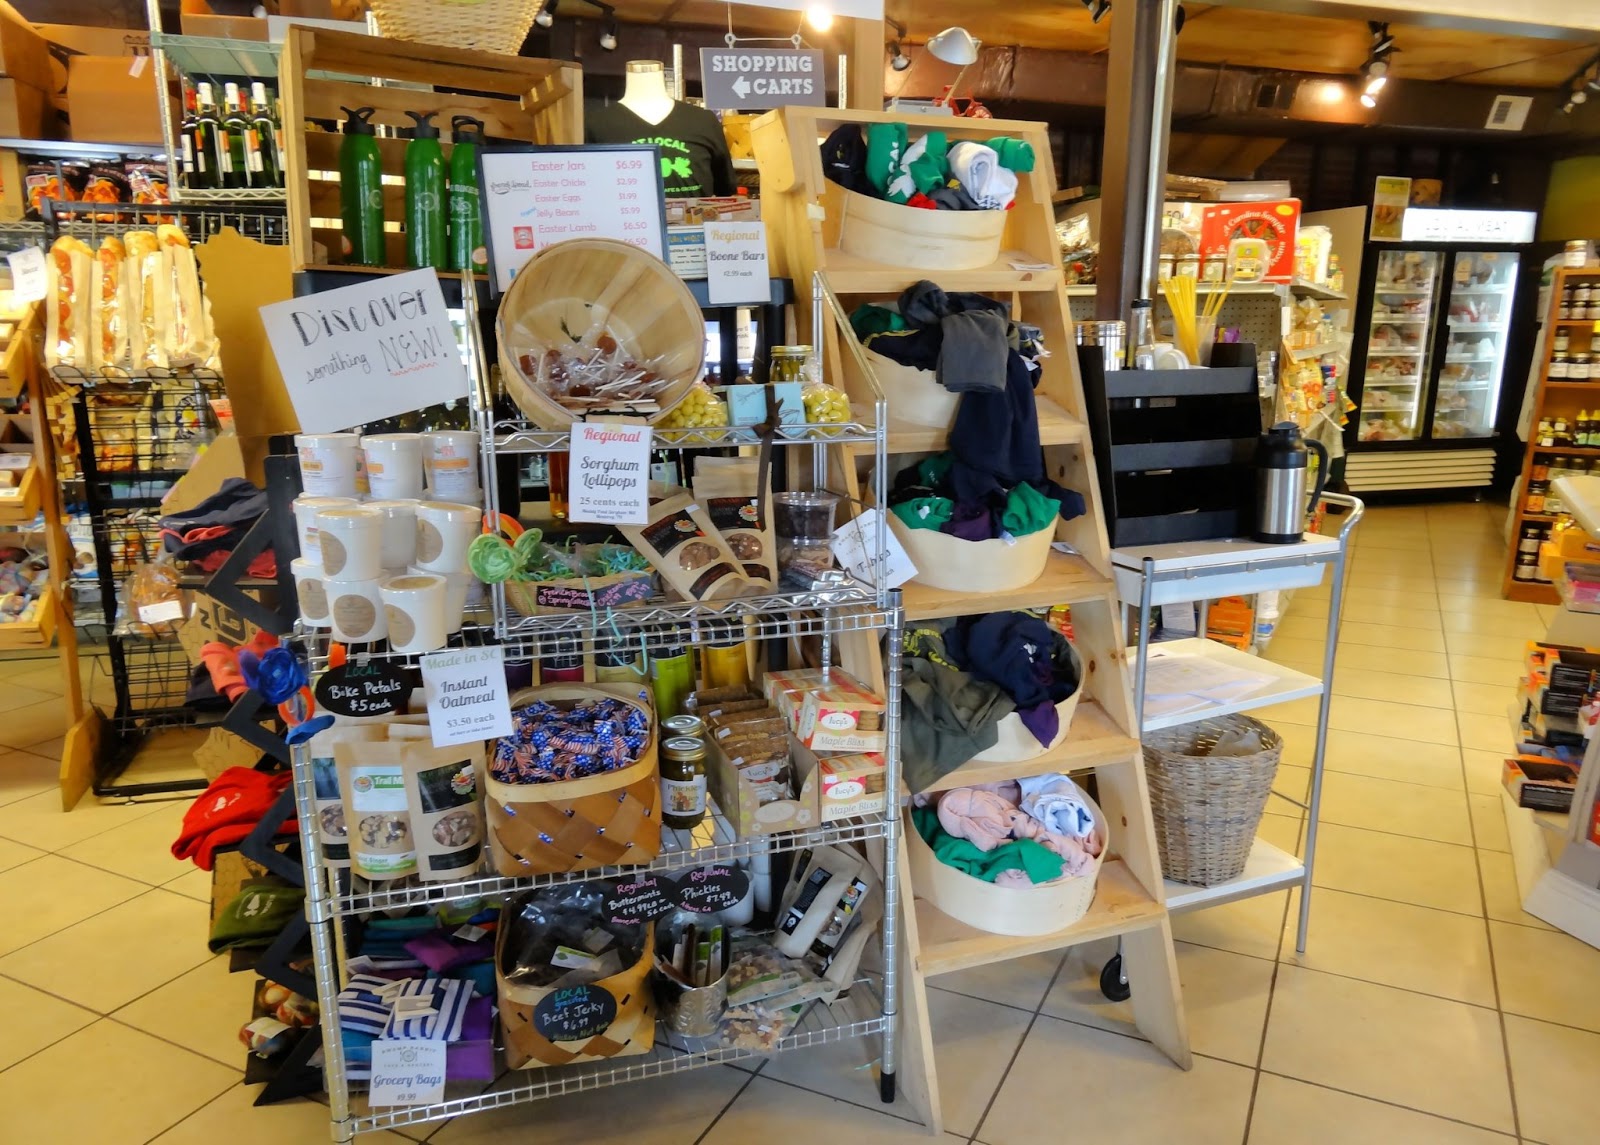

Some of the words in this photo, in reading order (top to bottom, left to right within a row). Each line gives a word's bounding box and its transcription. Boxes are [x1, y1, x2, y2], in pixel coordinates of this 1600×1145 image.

[711, 55, 813, 72] SHOPPING
[752, 78, 814, 95] CARTS
[531, 161, 564, 171] Easter
[567, 160, 586, 171] Jars
[615, 160, 642, 170] $6.99
[533, 179, 559, 188] Easter
[560, 178, 586, 187] Chicks
[616, 178, 638, 186] $2.99
[535, 193, 560, 203] Easter
[562, 193, 581, 204] Eggs
[618, 192, 637, 200] $1.99
[536, 208, 553, 218] Jelly
[555, 208, 580, 217] Beans
[620, 206, 640, 215] $5.99
[538, 224, 567, 233] Easter
[569, 222, 597, 232] Lamb
[623, 221, 647, 230] $6.50
[710, 229, 760, 243] Regional
[708, 251, 739, 261] Boone
[740, 250, 765, 261] Bars
[306, 351, 371, 385] something
[583, 427, 642, 444] Regional
[580, 456, 640, 474] Sorghum
[581, 472, 637, 490] Lollipops
[580, 496, 591, 505] 25
[618, 499, 640, 507] each
[425, 655, 461, 670] Made
[464, 653, 477, 664] in
[481, 648, 497, 661] SC
[344, 666, 382, 678] LOCAL
[328, 684, 360, 700] Bike
[363, 679, 401, 695] Petals
[440, 675, 488, 693] Instant
[350, 699, 368, 711] $5
[369, 700, 392, 711] each
[438, 689, 496, 710] Oatmeal
[446, 715, 472, 728] $3.50
[473, 713, 496, 723] each
[820, 736, 844, 746] Maple
[846, 737, 865, 746] Bliss
[830, 804, 856, 816] Maple
[859, 800, 878, 811] Bliss
[616, 878, 658, 895] Regional
[680, 885, 721, 900] Phickles
[723, 896, 739, 907] each
[555, 985, 591, 1001] LOCAL
[542, 1007, 570, 1026] Beef
[573, 1002, 605, 1018] Jerky
[562, 1017, 589, 1030] $6.99
[373, 1074, 413, 1089] Grocery
[415, 1073, 442, 1087] Bags
